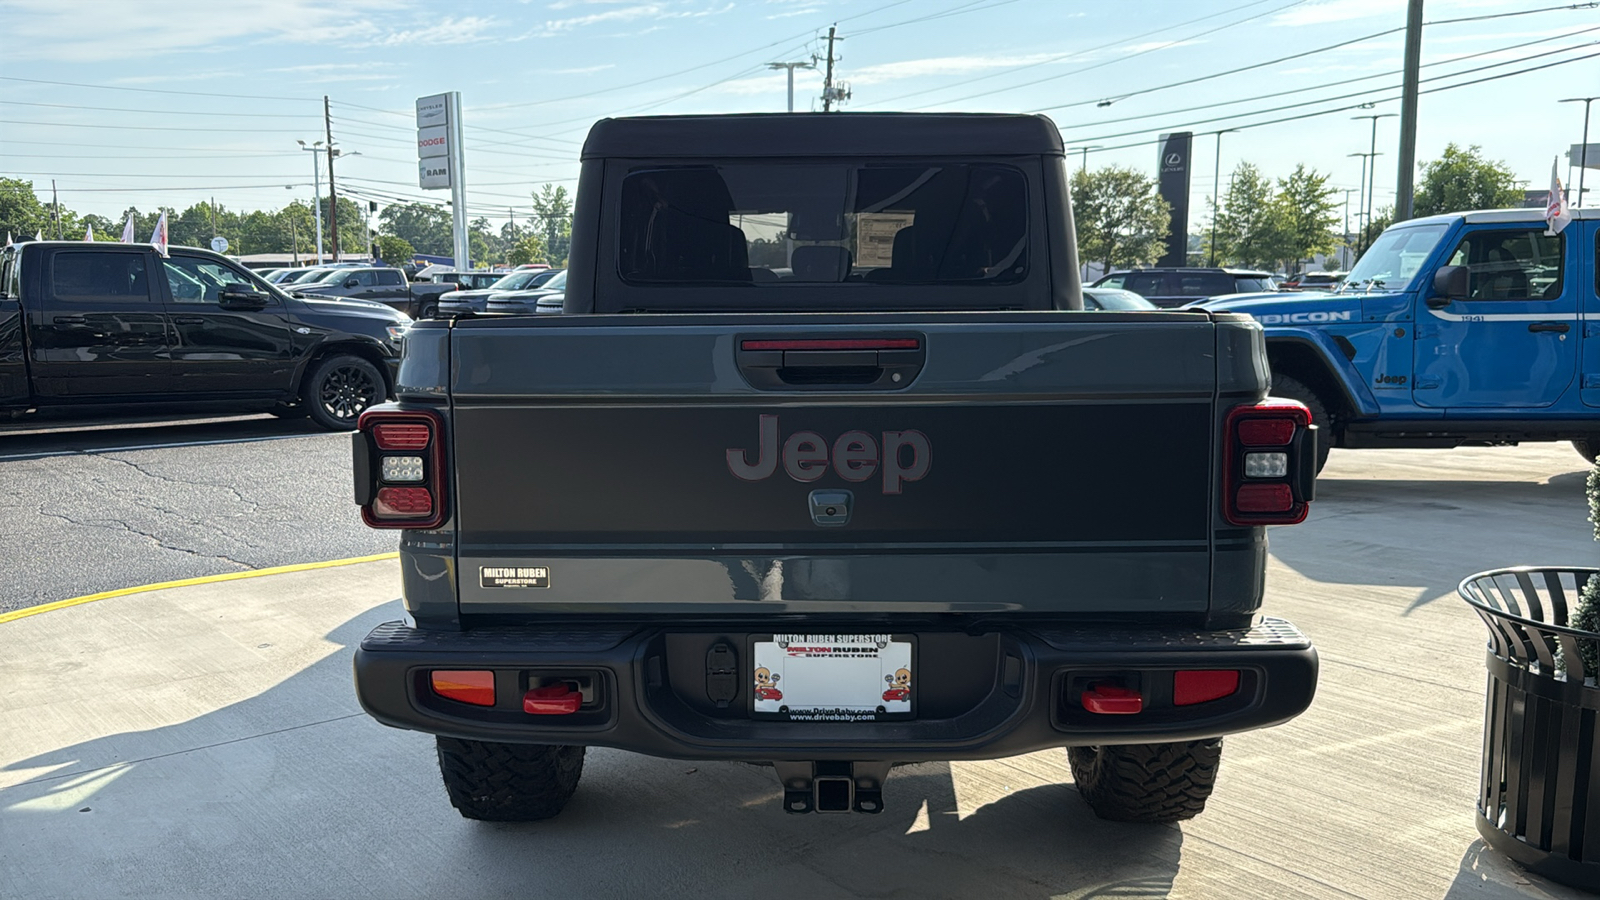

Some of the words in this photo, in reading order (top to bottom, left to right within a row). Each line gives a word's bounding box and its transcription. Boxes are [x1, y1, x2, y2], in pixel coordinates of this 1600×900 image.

[419, 137, 445, 147] DODGE
[427, 168, 446, 176] RAM
[1254, 311, 1351, 325] DICON
[1375, 373, 1408, 386] Jeep
[725, 413, 933, 495] Jeep
[484, 568, 515, 577] MILTON
[517, 568, 546, 577] RUBEN
[773, 634, 806, 643] MILTON
[807, 634, 835, 643] RUBEN
[836, 634, 892, 643] SUPERSTORE
[789, 714, 876, 722] www.drivebaby.com
